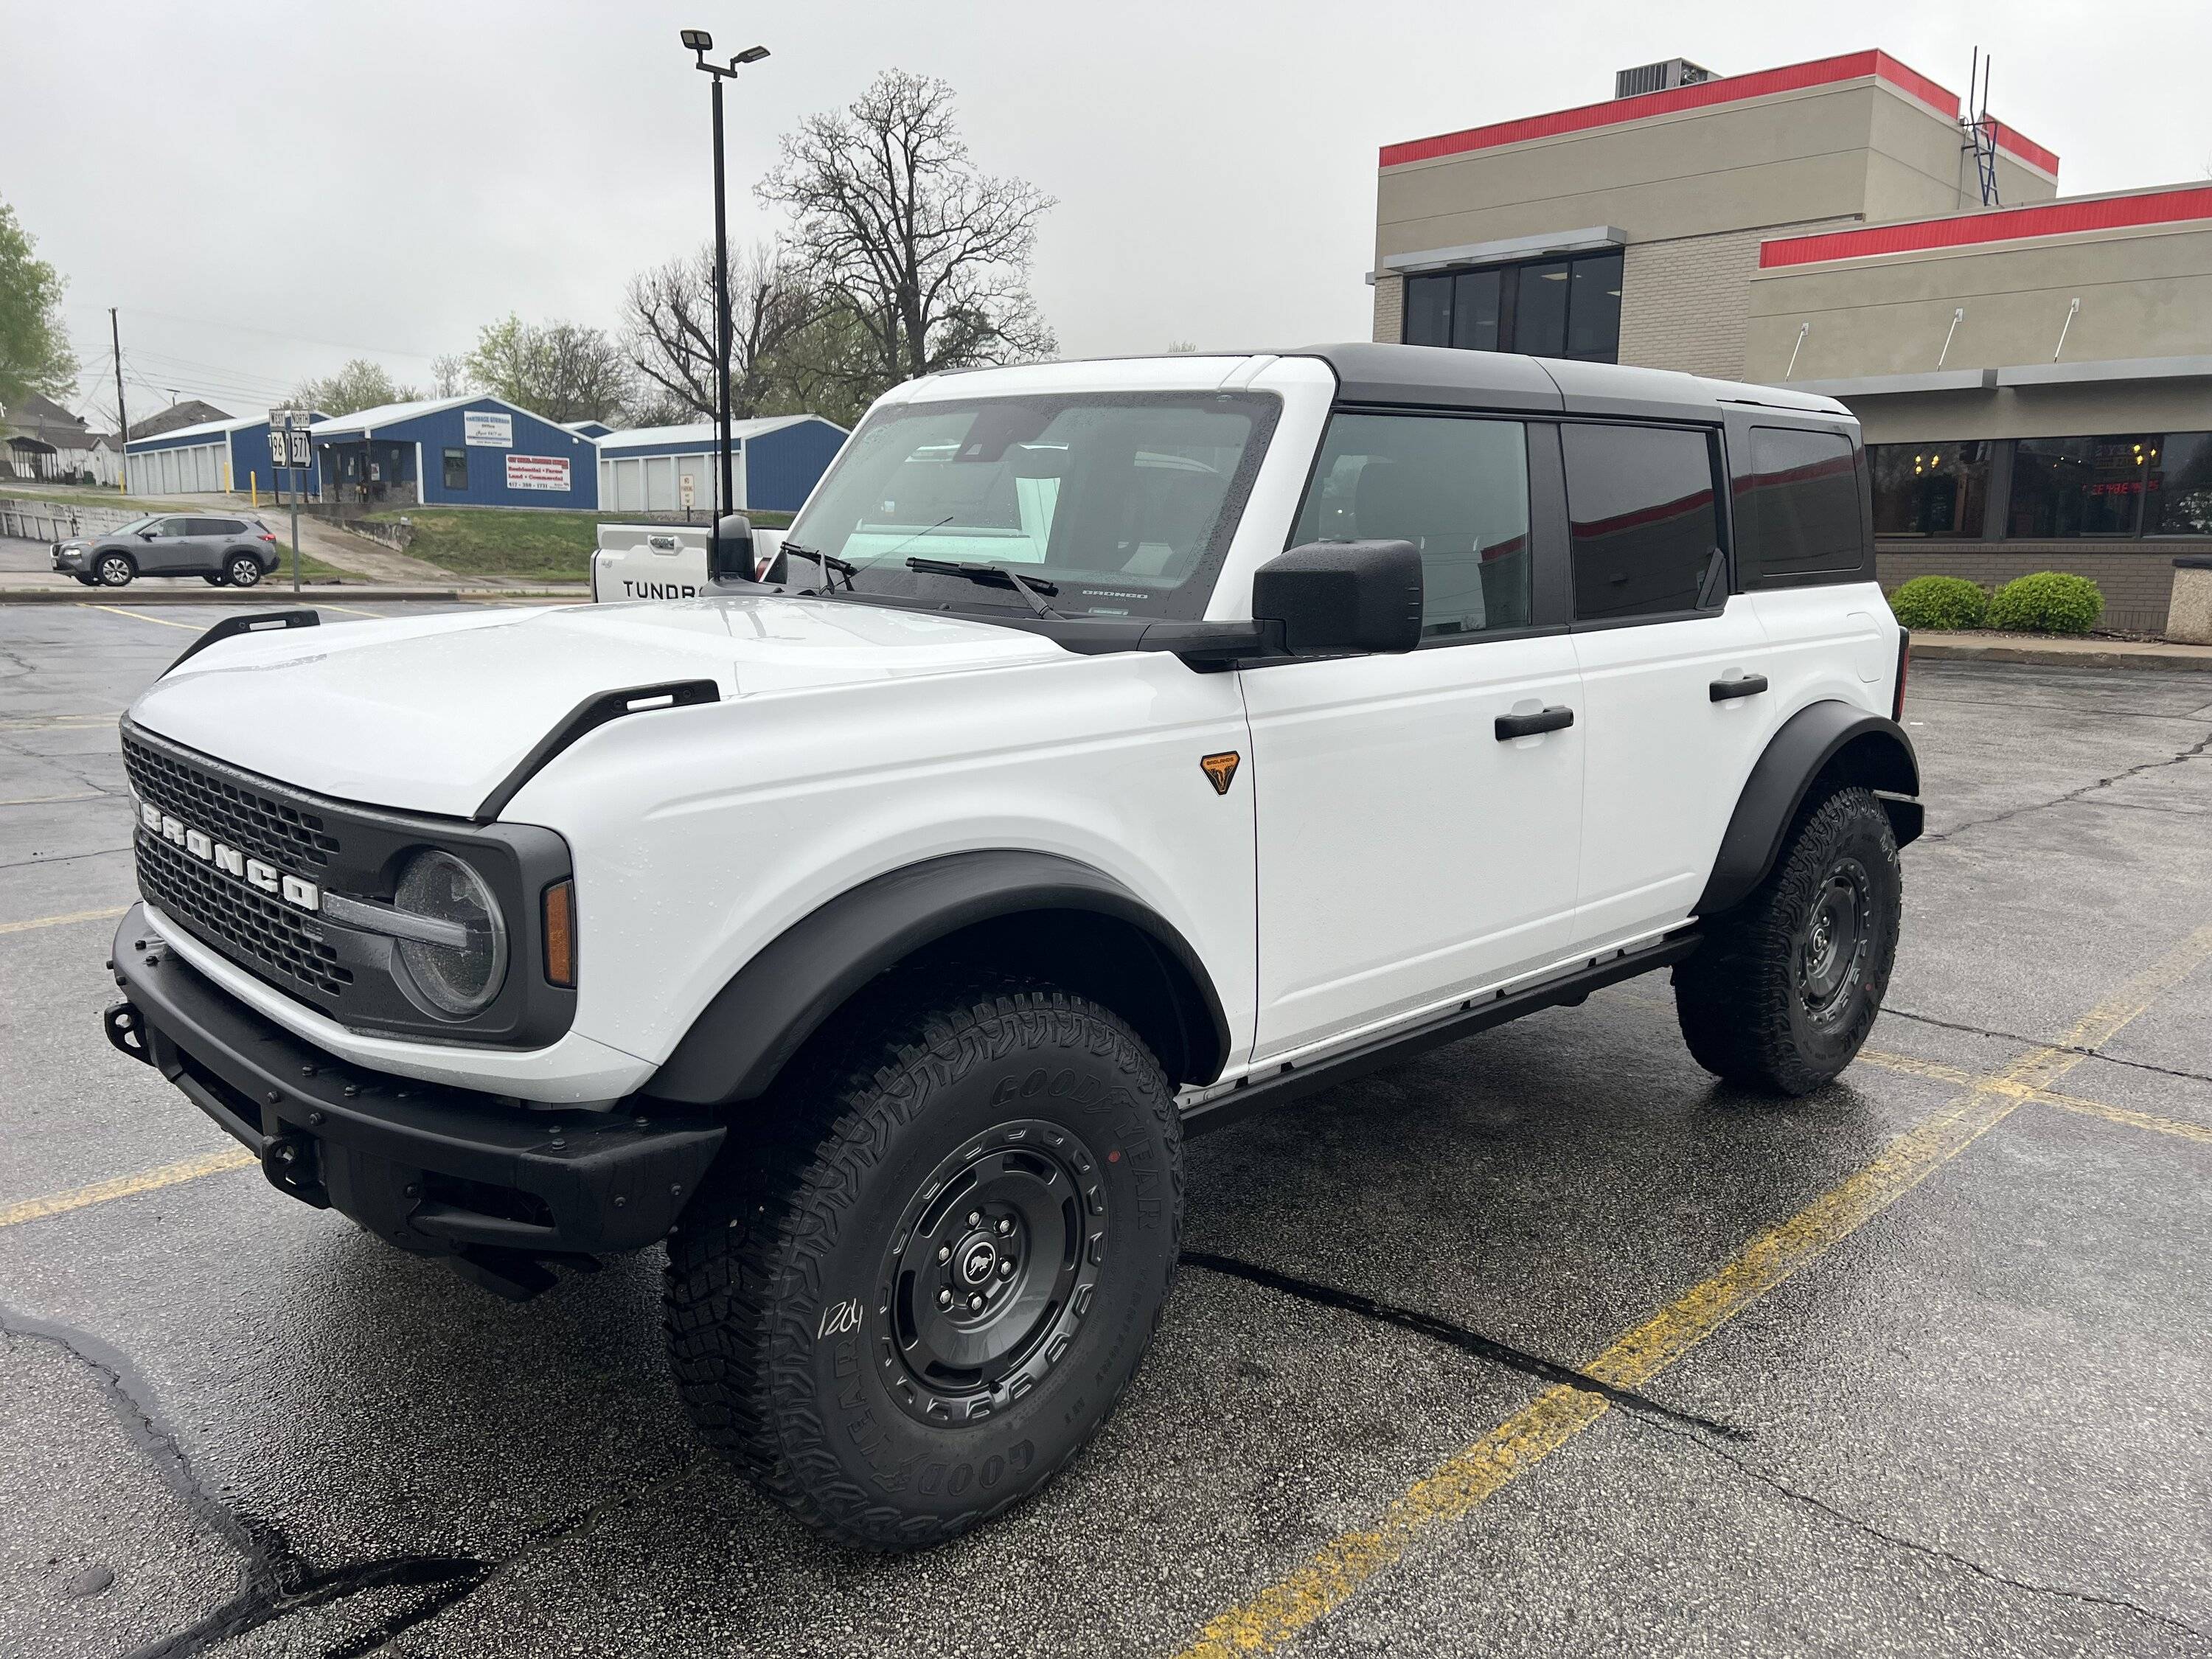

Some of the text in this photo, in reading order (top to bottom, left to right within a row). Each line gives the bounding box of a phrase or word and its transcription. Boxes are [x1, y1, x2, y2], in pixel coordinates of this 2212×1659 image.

[271, 413, 283, 424] WEST
[292, 412, 309, 424] NORTH
[274, 437, 282, 456] 96
[294, 437, 307, 457] 571
[623, 580, 703, 599] TUNDR
[1082, 590, 1148, 599] BRONCO
[1206, 757, 1234, 765] BADLANDS
[142, 802, 320, 911] BRONCO
